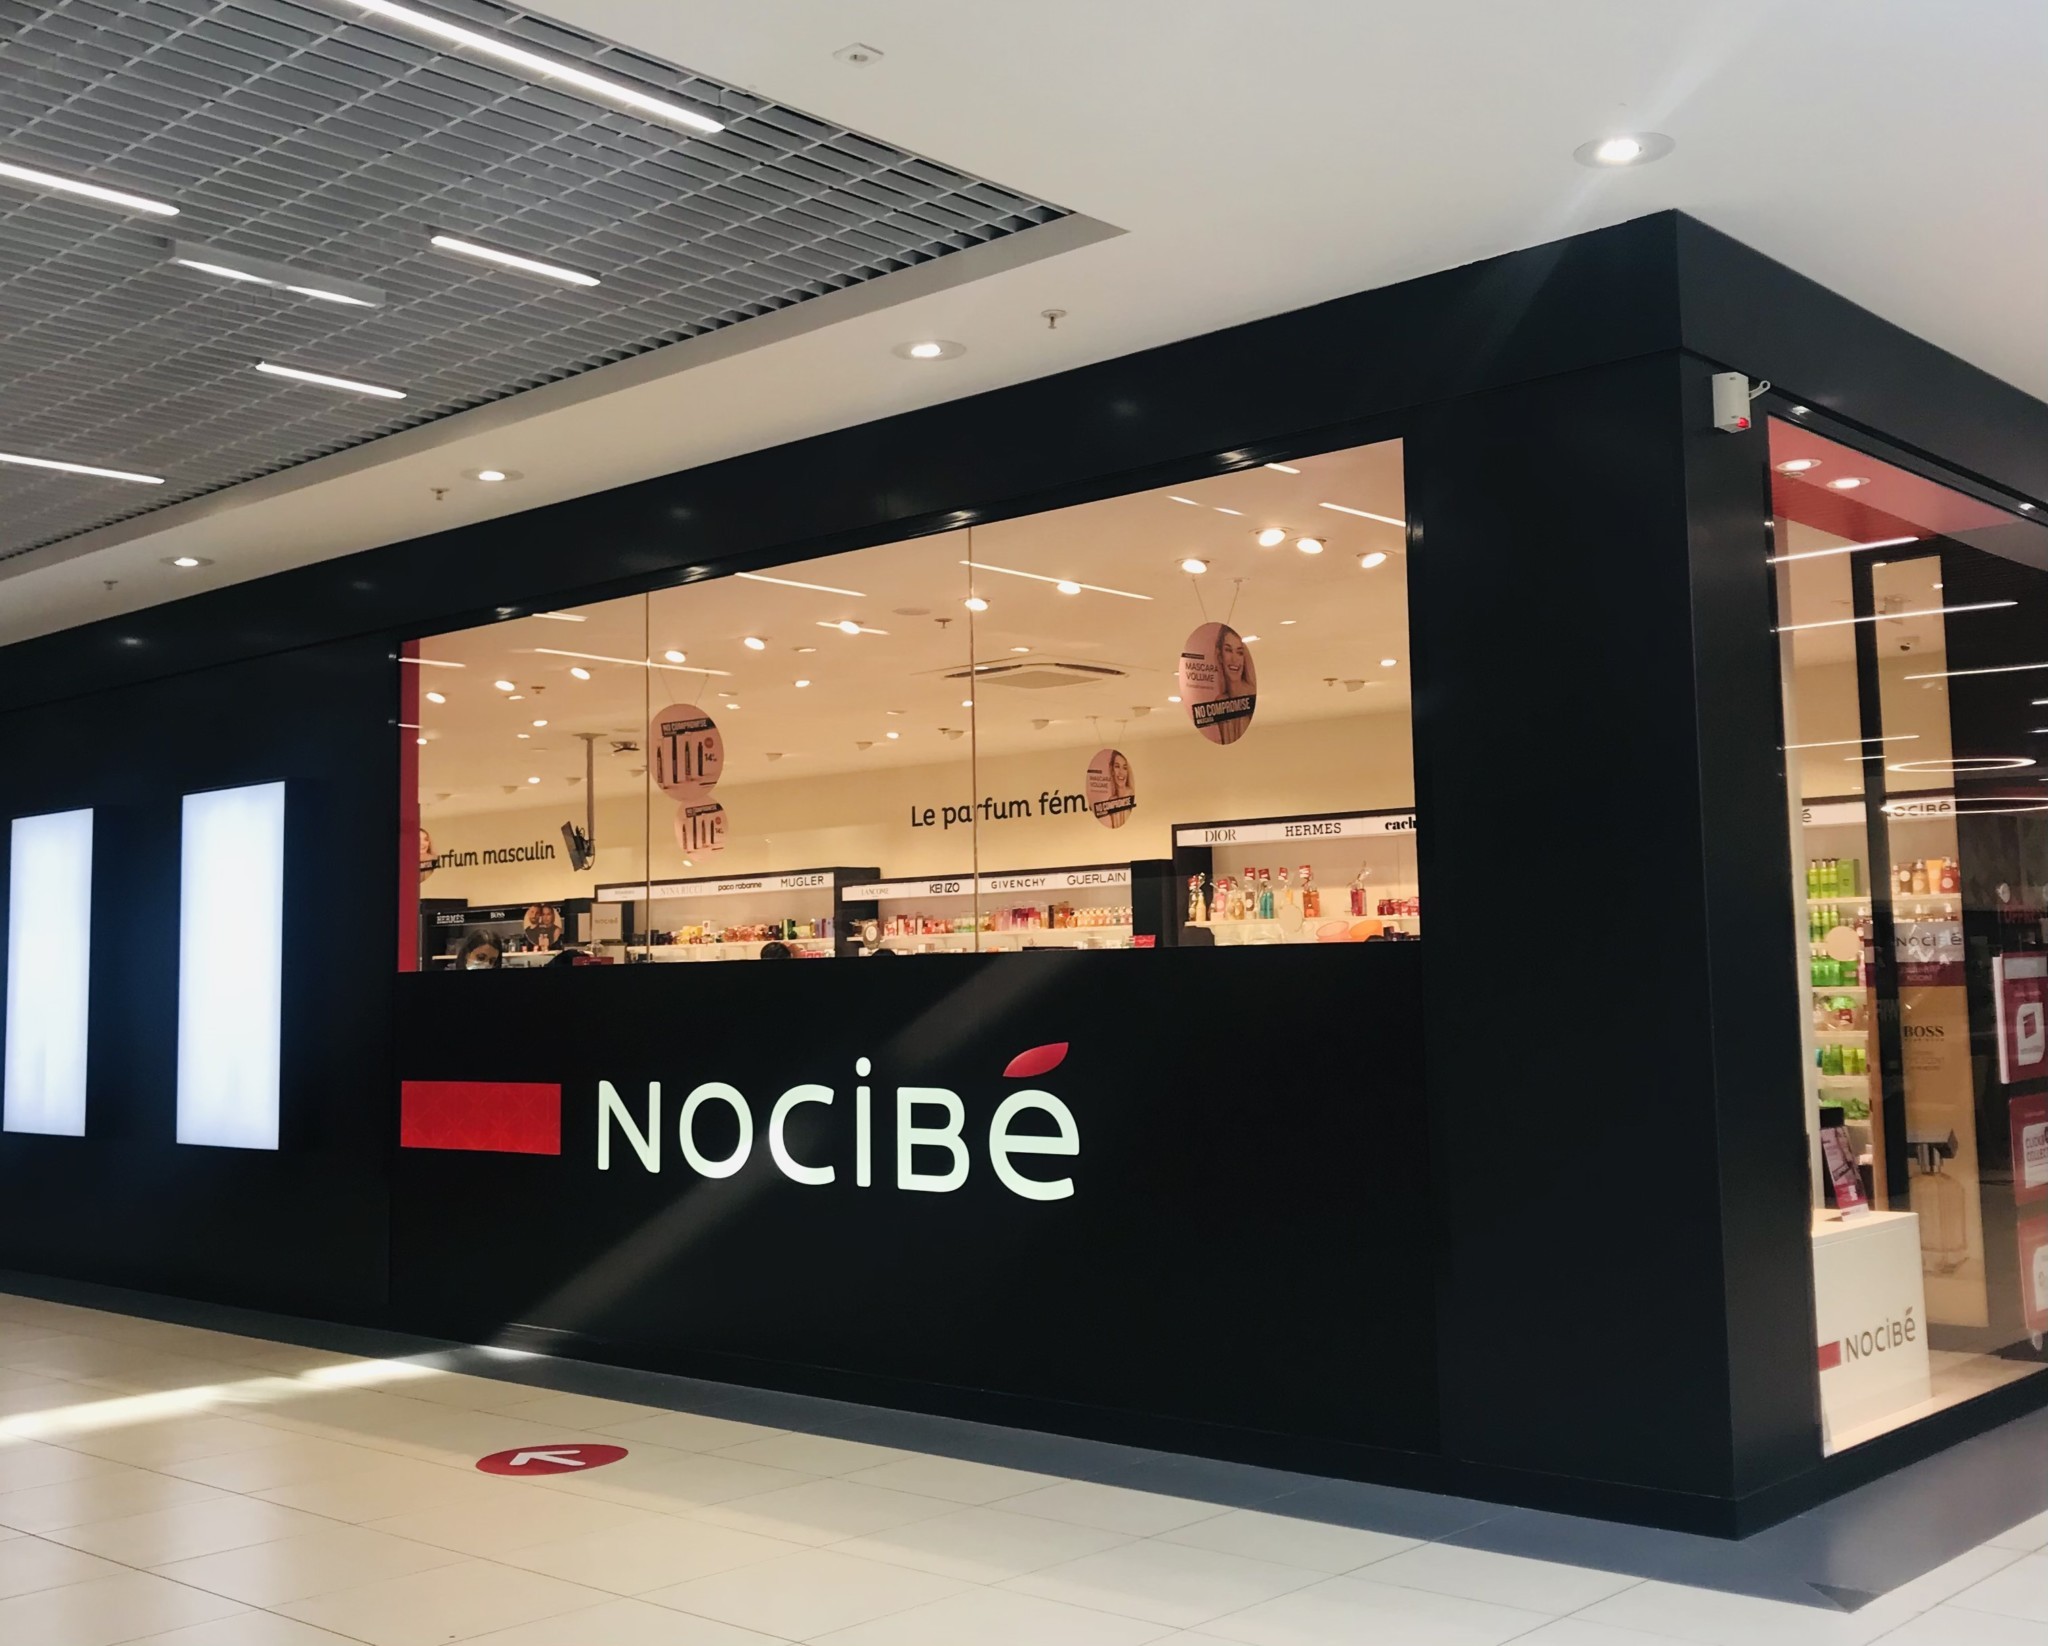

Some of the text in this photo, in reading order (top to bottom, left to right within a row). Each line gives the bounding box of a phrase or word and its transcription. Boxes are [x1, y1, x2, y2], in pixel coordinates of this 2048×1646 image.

[1185, 662, 1219, 673] MASCARA
[1185, 671, 1216, 683] VOLUME
[1194, 697, 1251, 719] NO COMPROMISE
[912, 805, 935, 828] Le
[1204, 829, 1237, 842] DIOR
[482, 840, 556, 865] masculin
[780, 874, 825, 889] MUGLER
[990, 877, 1046, 890] GIVENCHY
[1066, 871, 1127, 886] GUERLAIN
[717, 880, 762, 892] paco rabanne
[929, 882, 960, 895] KENZO
[1903, 1025, 1945, 1038] BOSS
